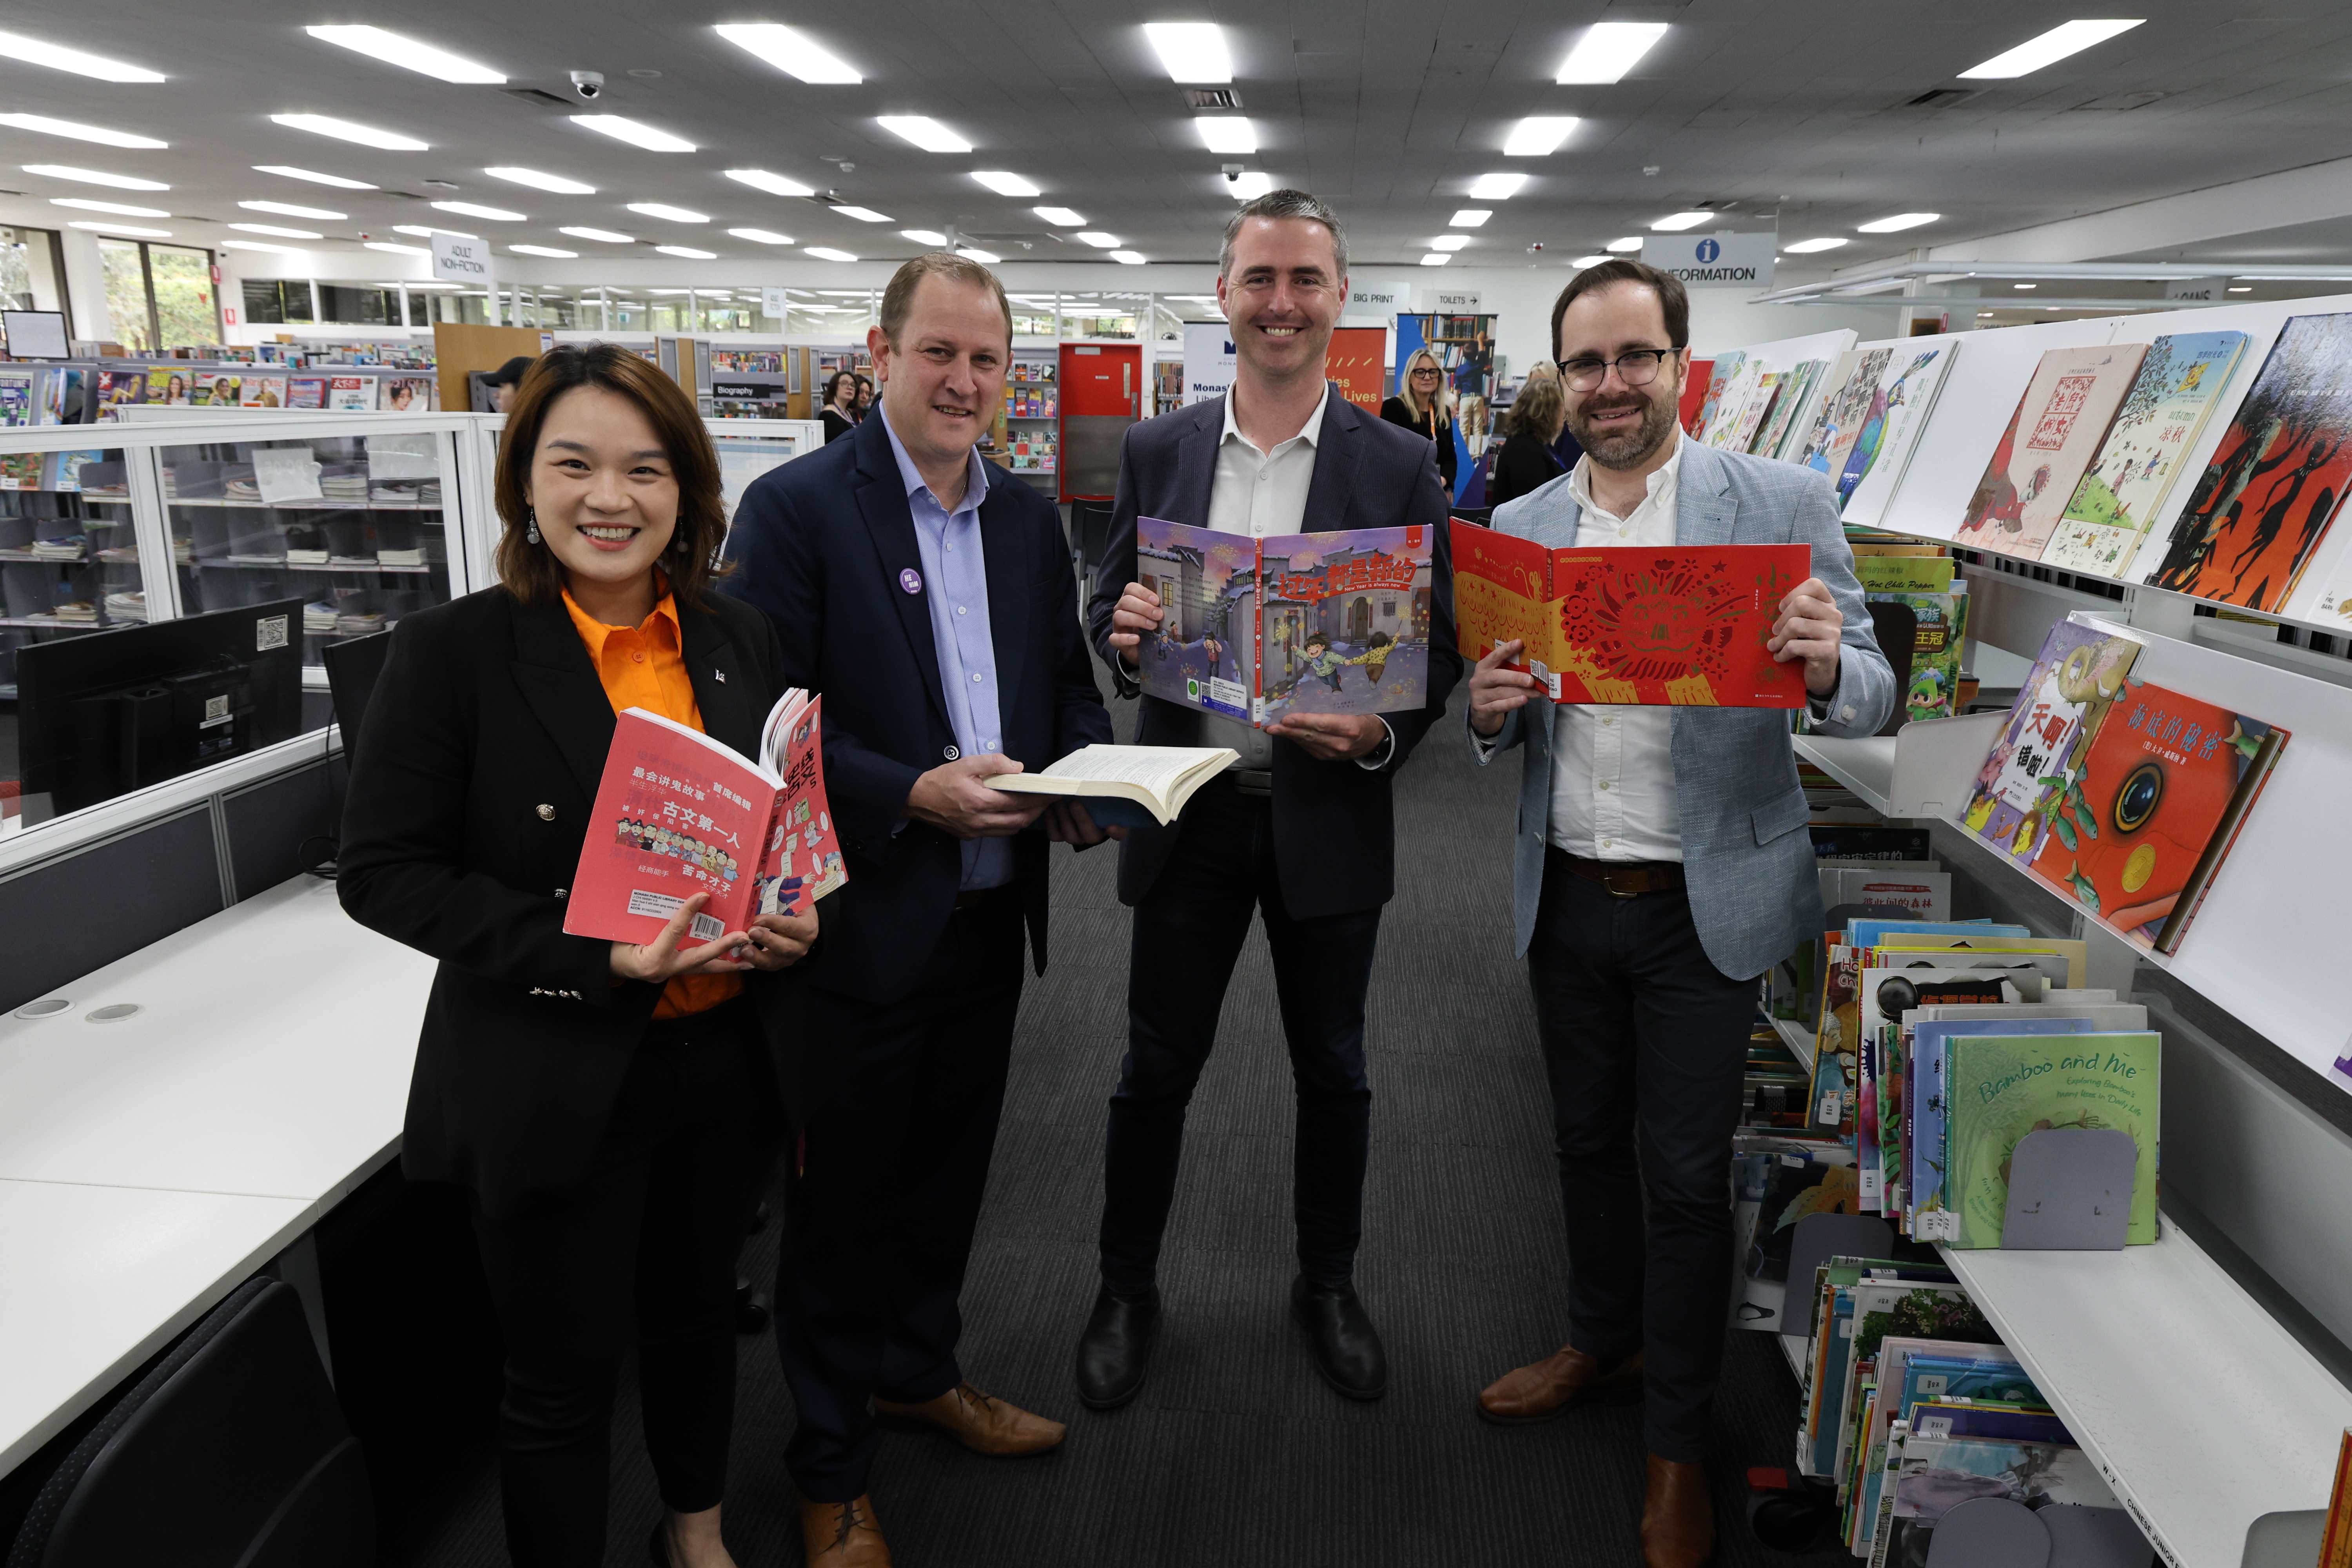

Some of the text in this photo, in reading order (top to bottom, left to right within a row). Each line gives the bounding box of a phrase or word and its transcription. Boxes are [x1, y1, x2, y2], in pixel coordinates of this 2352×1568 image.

[452, 241, 472, 258] ADULT
[441, 257, 485, 273] NON-FICTION
[1662, 267, 1756, 281] FORMATION
[1354, 294, 1394, 303] BIG PRINT
[1439, 296, 1466, 305] TOILETS
[0, 378, 26, 388] ORTUNE
[717, 386, 753, 396] Biography
[1344, 390, 1377, 402] Lives
[2168, 409, 2195, 421] autumn
[2159, 425, 2186, 443] 凉秋
[904, 574, 912, 582] HE
[1277, 552, 1417, 606] 过年都是新的
[1884, 580, 1905, 588] Chili
[1907, 581, 1935, 590] Pepper
[1913, 608, 1941, 622] 家族
[1915, 632, 1944, 645] 王冠
[2127, 703, 2223, 761] 海底的秘密
[629, 778, 667, 796] 半生浮华
[632, 766, 706, 802] 最会讲鬼故事
[810, 778, 817, 789] 5
[712, 782, 752, 811] 首席编辑
[662, 801, 740, 849] 古文第一人
[637, 864, 670, 877] 经商能手
[682, 864, 731, 892] 苦命才子
[701, 883, 729, 900] 文学天才
[1979, 1053, 2137, 1104] Bamboo and Me
[2066, 1076, 2136, 1098] Exploring Bamboo's
[2107, 1094, 2128, 1110] Daily
[2129, 1105, 2142, 1117] Life
[2103, 1463, 2109, 1475] W
[2111, 1476, 2116, 1486] X
[2127, 1499, 2174, 1566] CHINESE JUNIOR
